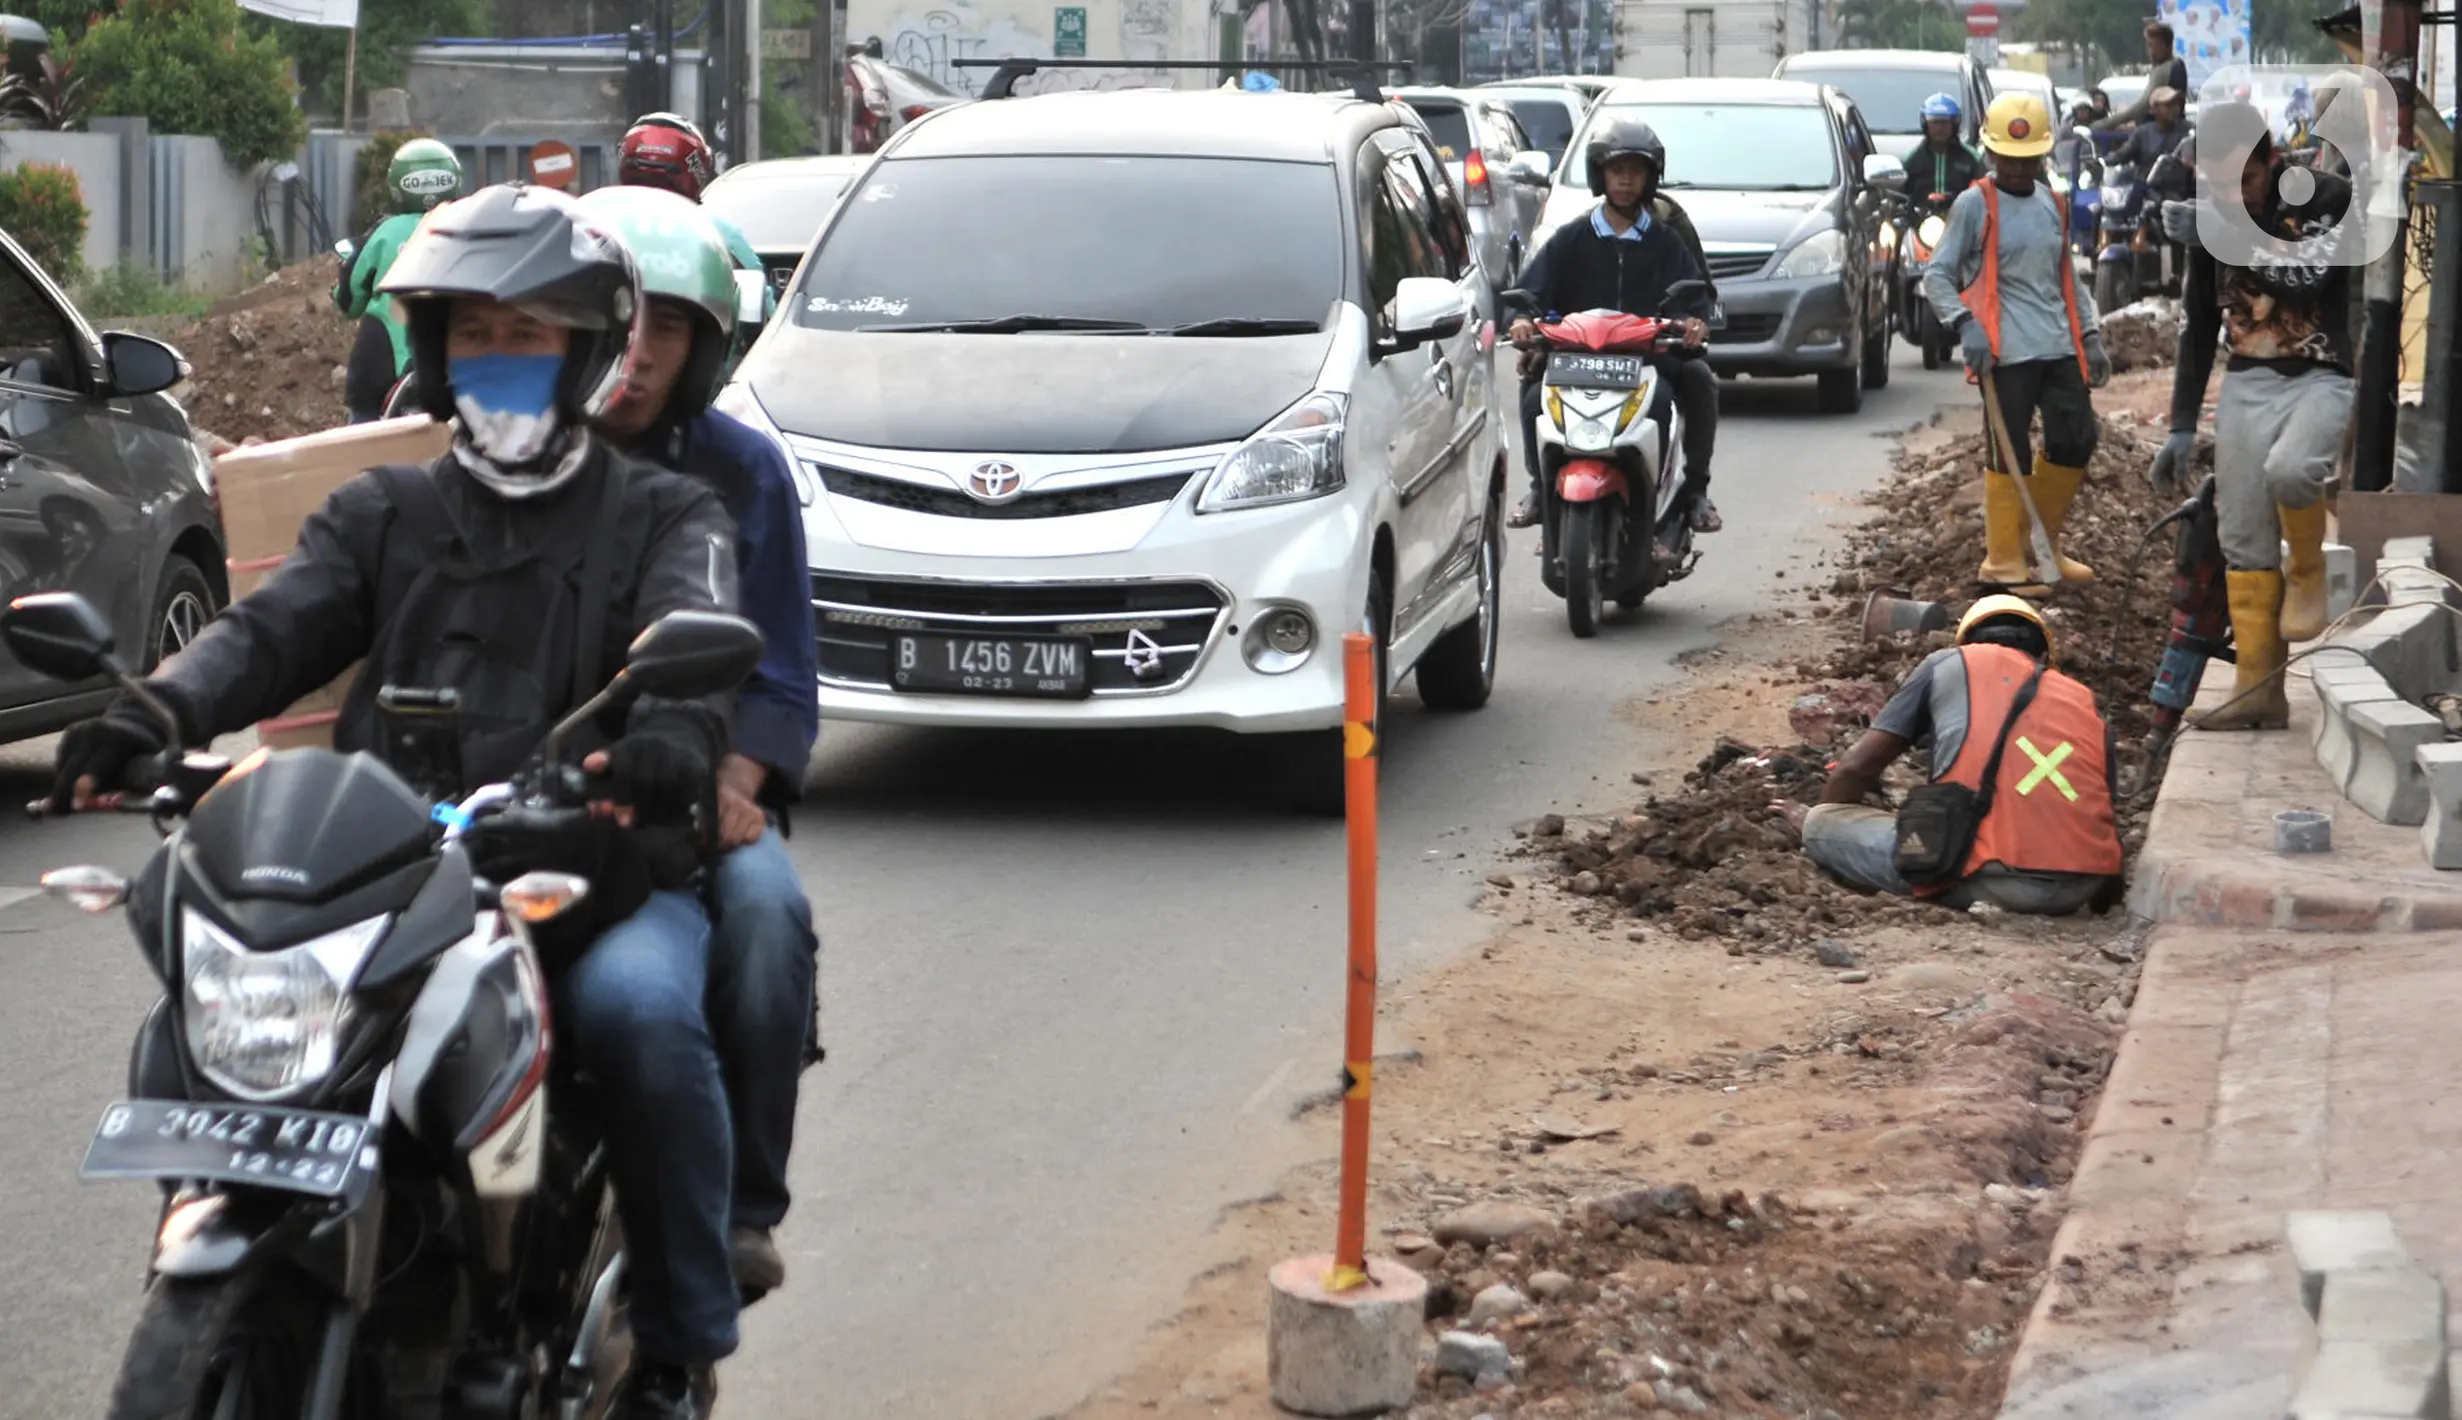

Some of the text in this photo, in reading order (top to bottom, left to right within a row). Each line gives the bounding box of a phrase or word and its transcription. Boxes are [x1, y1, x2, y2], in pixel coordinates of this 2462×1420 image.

[900, 638, 1076, 677] B 1456 ZVM
